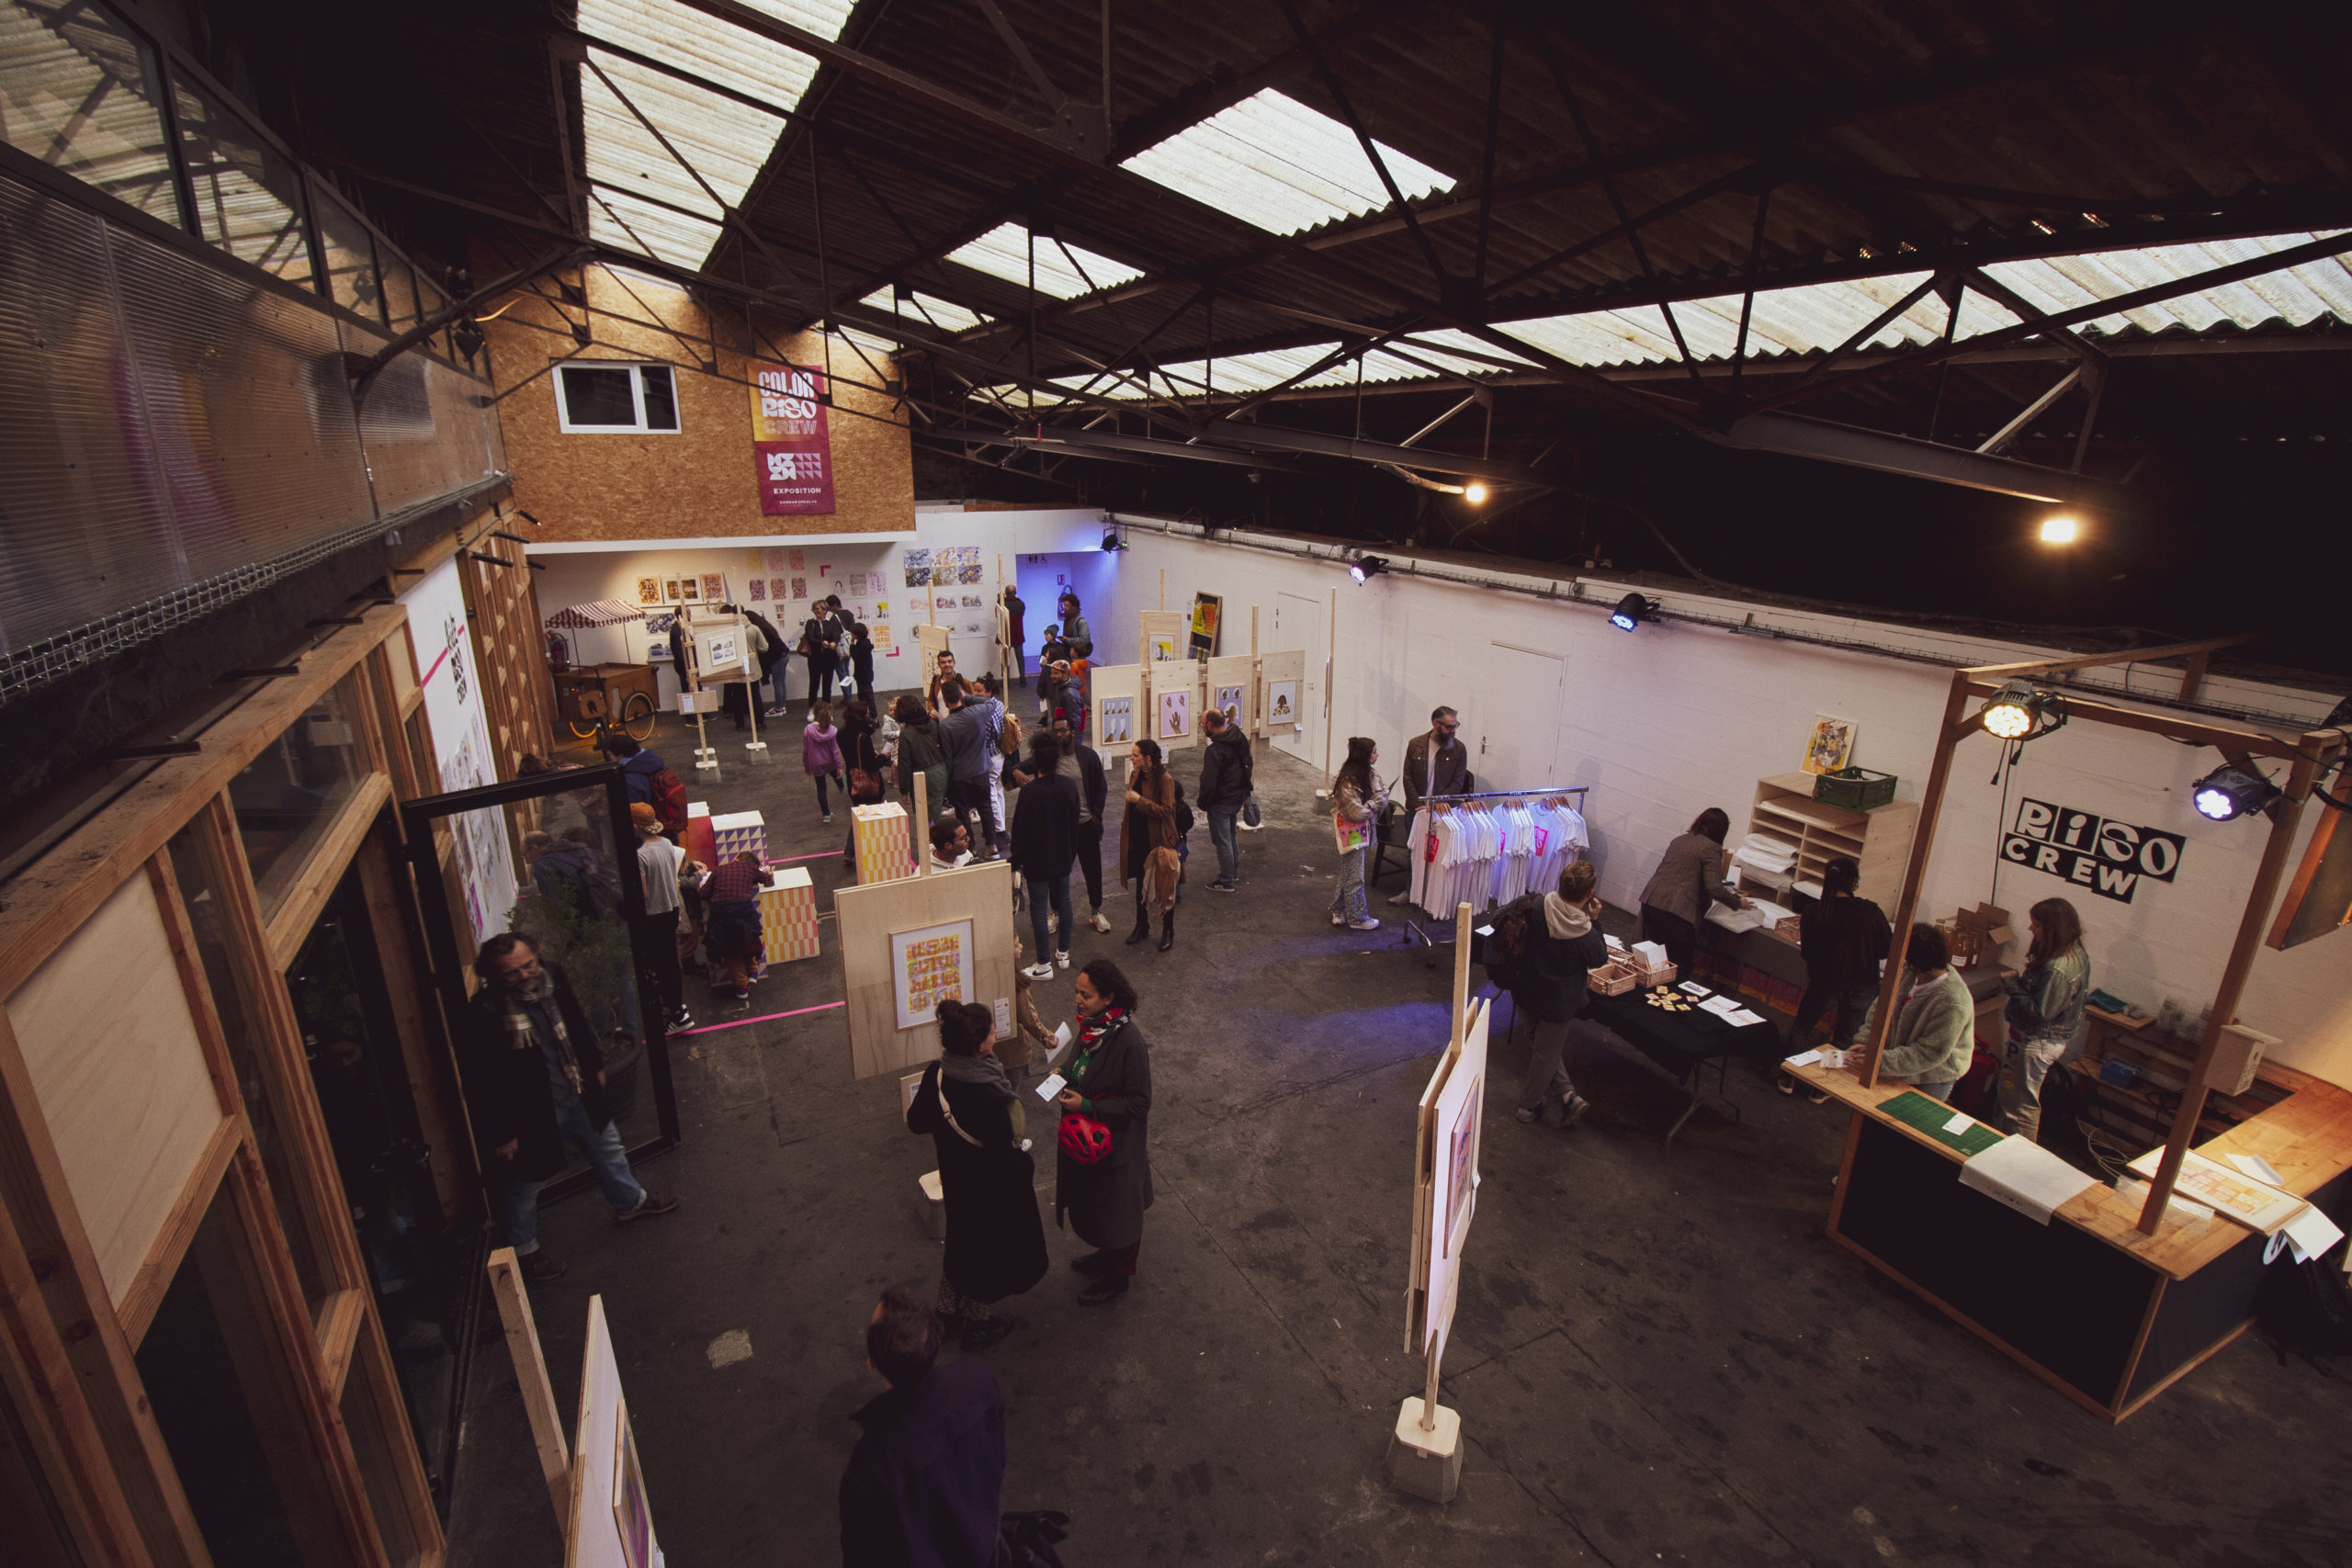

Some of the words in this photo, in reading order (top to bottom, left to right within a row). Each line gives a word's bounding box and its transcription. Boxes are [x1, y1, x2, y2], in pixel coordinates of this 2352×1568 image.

[759, 371, 815, 398] COLOR
[763, 420, 817, 434] CREW
[2005, 837, 2138, 896] CREW
